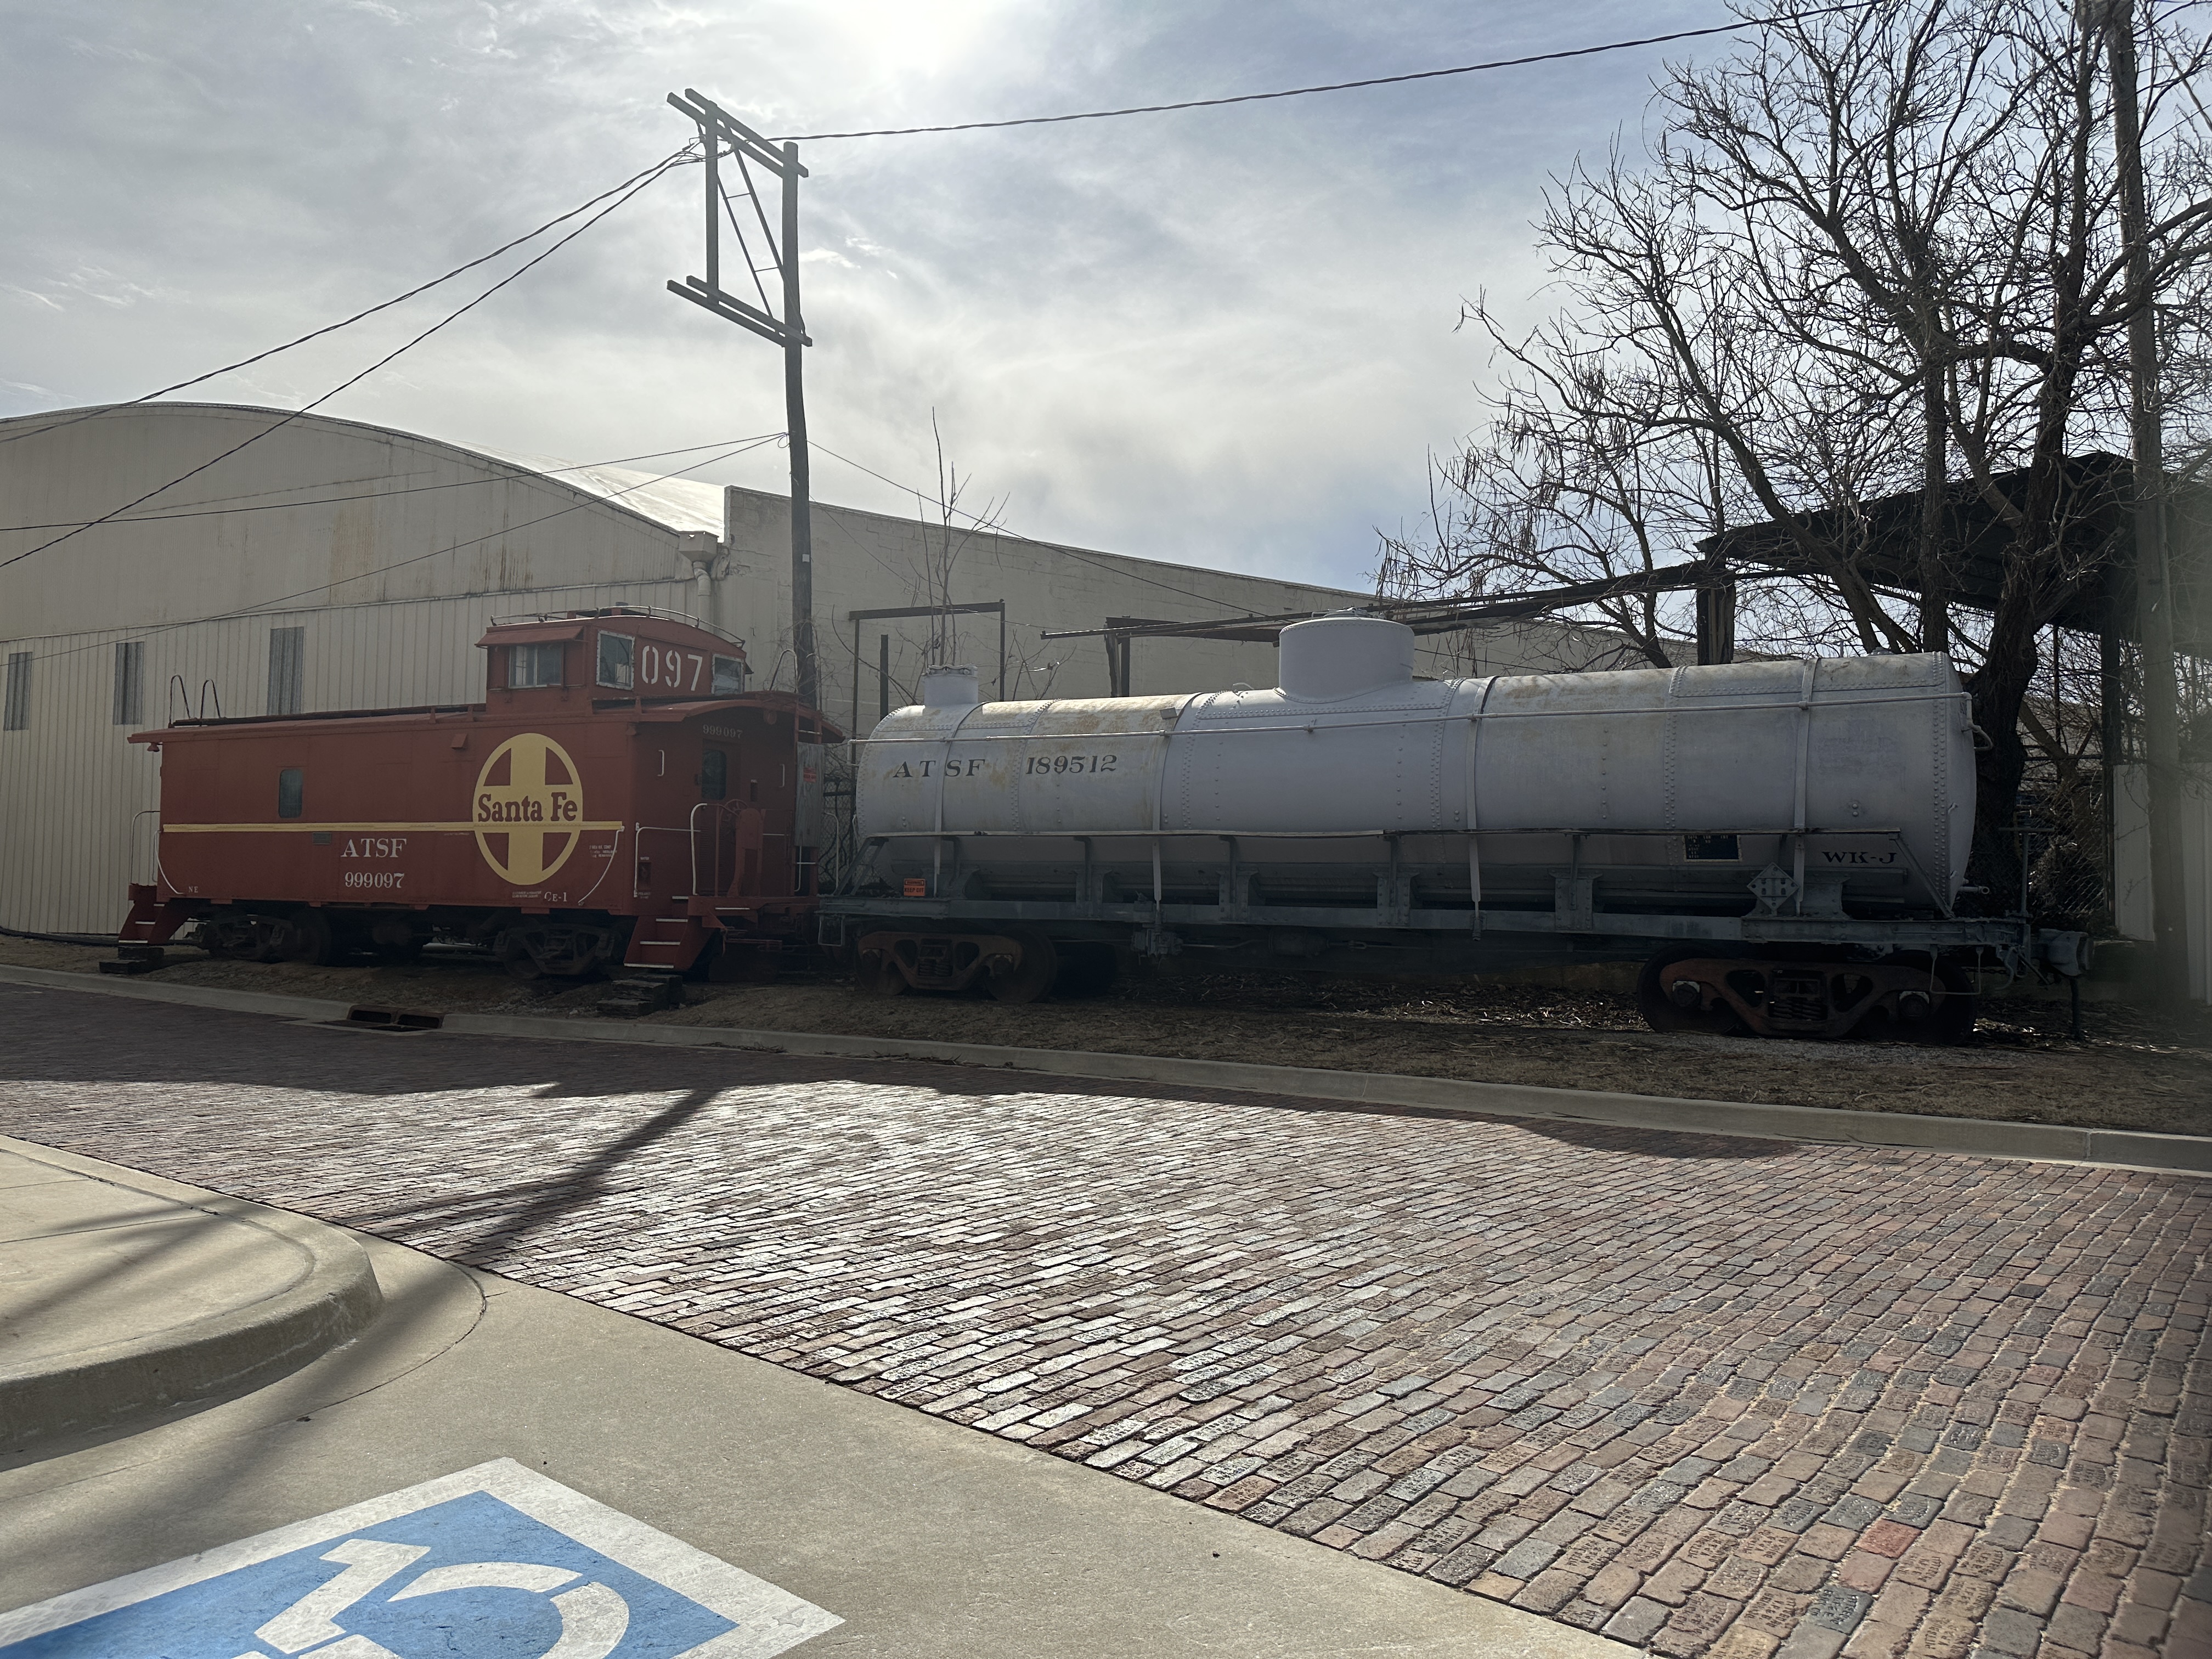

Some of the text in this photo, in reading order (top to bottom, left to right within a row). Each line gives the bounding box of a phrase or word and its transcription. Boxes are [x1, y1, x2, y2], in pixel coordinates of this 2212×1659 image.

[642, 645, 703, 691] 097
[703, 724, 743, 739] 999097
[1025, 754, 1118, 776] 189512
[478, 792, 578, 822] Santa Fe
[341, 838, 407, 858] ATSF
[1821, 851, 1898, 864] WK-J
[345, 872, 405, 888] 999097
[1618, 1522, 1640, 1537] BRICK
